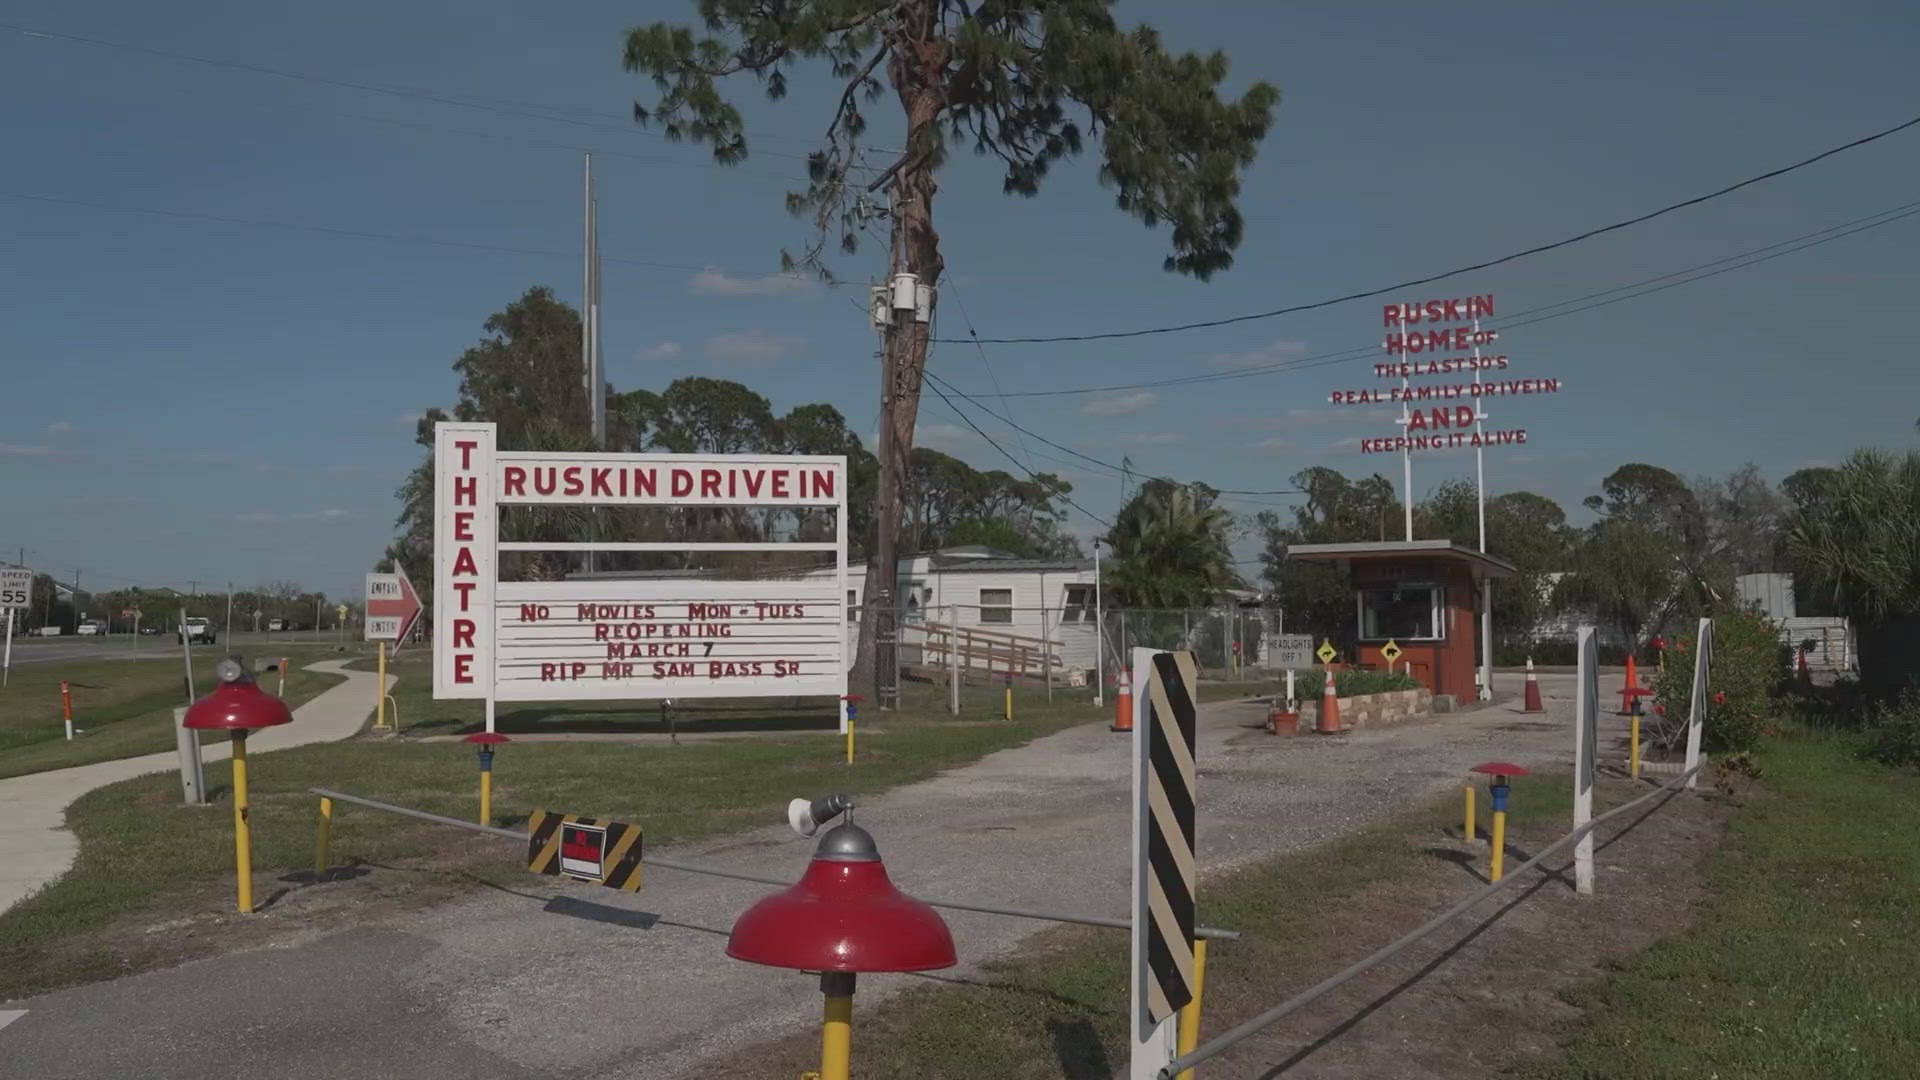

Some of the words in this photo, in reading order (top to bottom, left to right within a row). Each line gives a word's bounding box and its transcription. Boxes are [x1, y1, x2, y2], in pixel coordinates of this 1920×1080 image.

[1383, 294, 1494, 327] RUSKIN
[1385, 327, 1470, 355] HOME
[1473, 330, 1497, 346] OF
[1332, 386, 1383, 405] REAL
[1391, 385, 1463, 403] FAMILY
[1408, 405, 1474, 432] AND
[1361, 434, 1443, 454] KEEPING
[1449, 432, 1466, 448] IT
[1470, 429, 1526, 448] ALIVE
[504, 466, 658, 497] RUSKIN
[452, 441, 478, 685] THEATRE
[2, 571, 30, 579] SPEED
[2, 590, 26, 603] 55
[520, 603, 550, 622] NO
[577, 603, 655, 622] MOVIES
[595, 623, 732, 641] REOPENING
[607, 641, 690, 660] MARCH
[703, 641, 714, 657] 7
[1269, 639, 1312, 649] HEADLIGHTS
[541, 662, 587, 681] RIP
[602, 661, 634, 680] MR
[652, 661, 695, 680] SAM
[708, 660, 763, 679] BASS
[773, 659, 800, 678] SR
